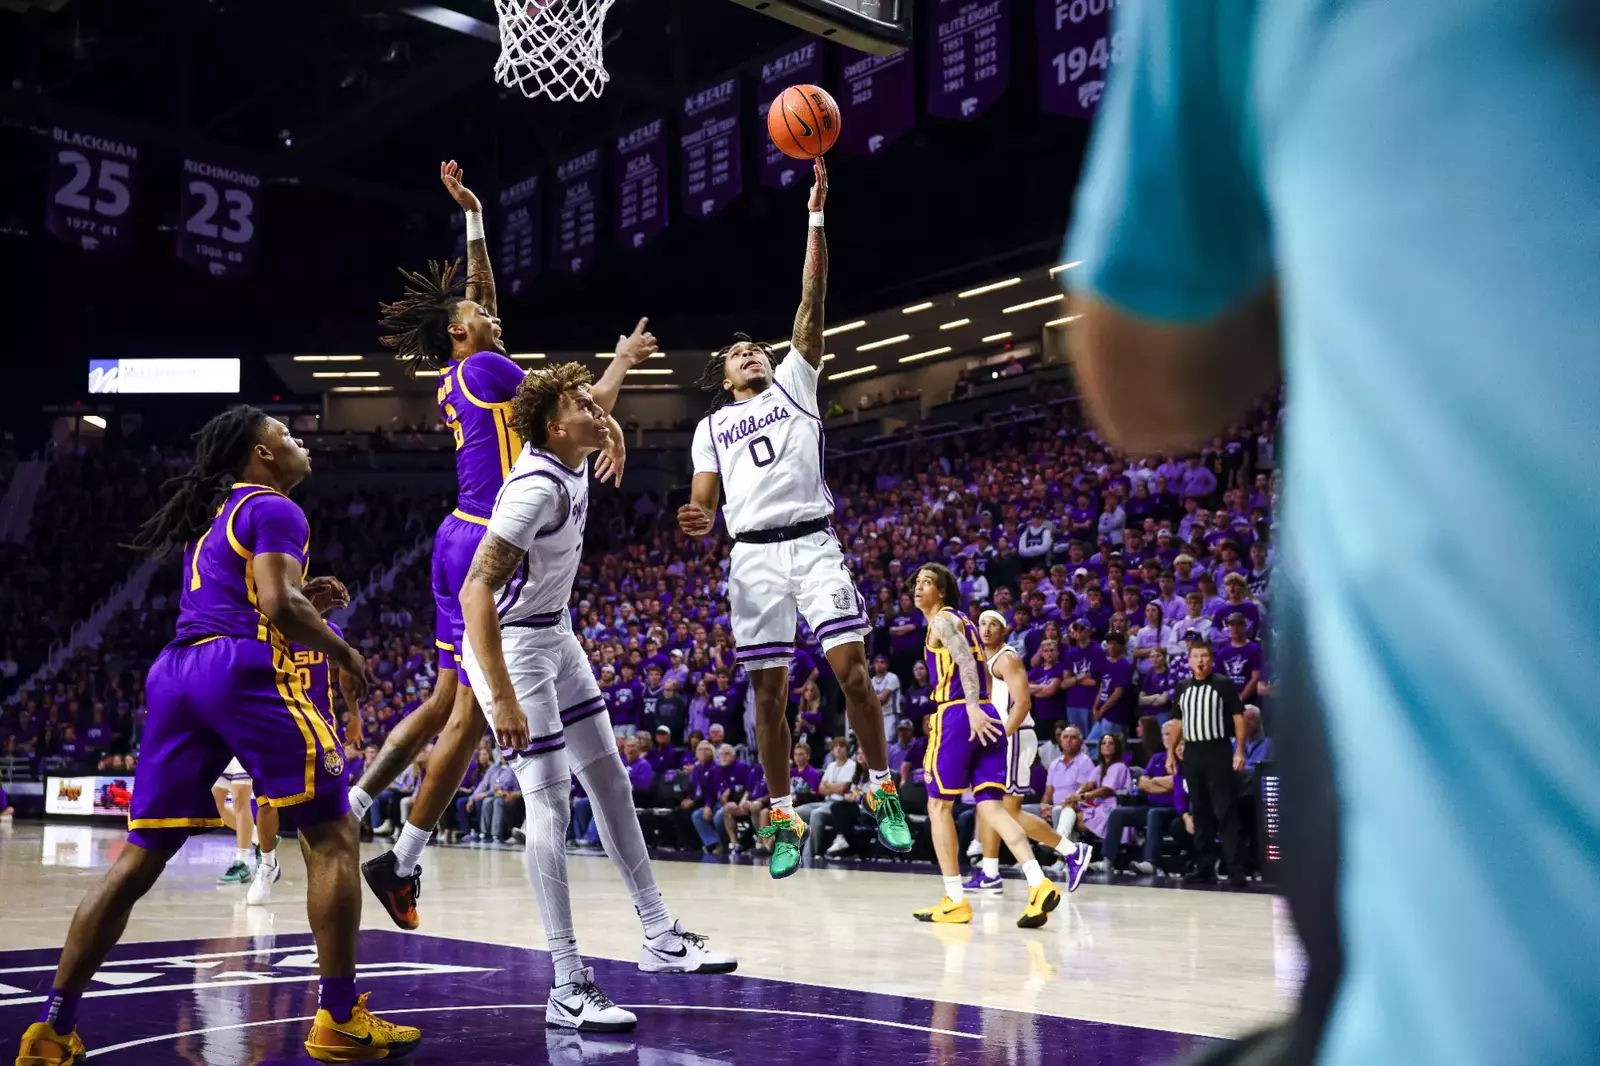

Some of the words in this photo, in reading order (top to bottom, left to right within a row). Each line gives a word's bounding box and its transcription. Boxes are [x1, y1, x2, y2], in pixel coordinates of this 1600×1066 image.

[938, 16, 966, 38] ELITE
[968, 0, 1001, 26] EIGHT
[52, 126, 138, 161] BLACKMAN
[54, 149, 131, 217] 25
[184, 158, 260, 188] RICHMOND
[186, 181, 255, 243] 23
[717, 405, 791, 450] Wildcats
[748, 435, 776, 468] 0
[190, 526, 213, 593] 1
